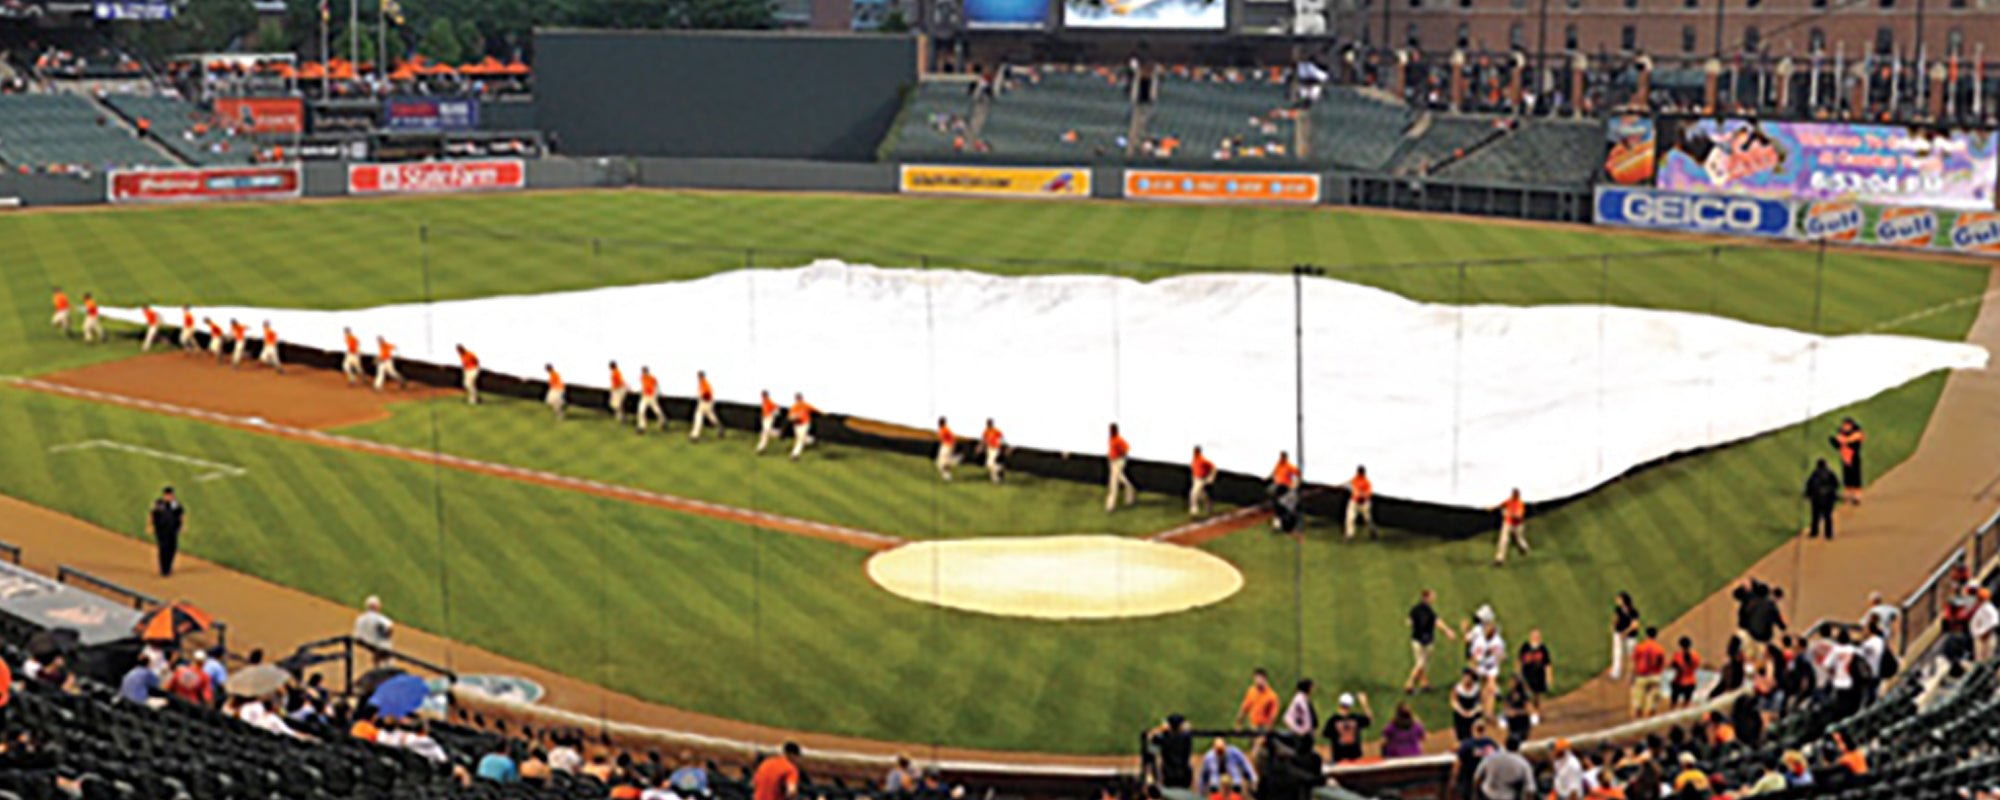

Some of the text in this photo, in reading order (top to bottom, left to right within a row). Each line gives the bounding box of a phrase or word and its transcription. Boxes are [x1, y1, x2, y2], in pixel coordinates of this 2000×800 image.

[1622, 193, 1761, 230] GEICO
[1808, 211, 1858, 235] Gulf
[1877, 213, 1932, 241] Gulf
[1953, 216, 2000, 246] Gul
